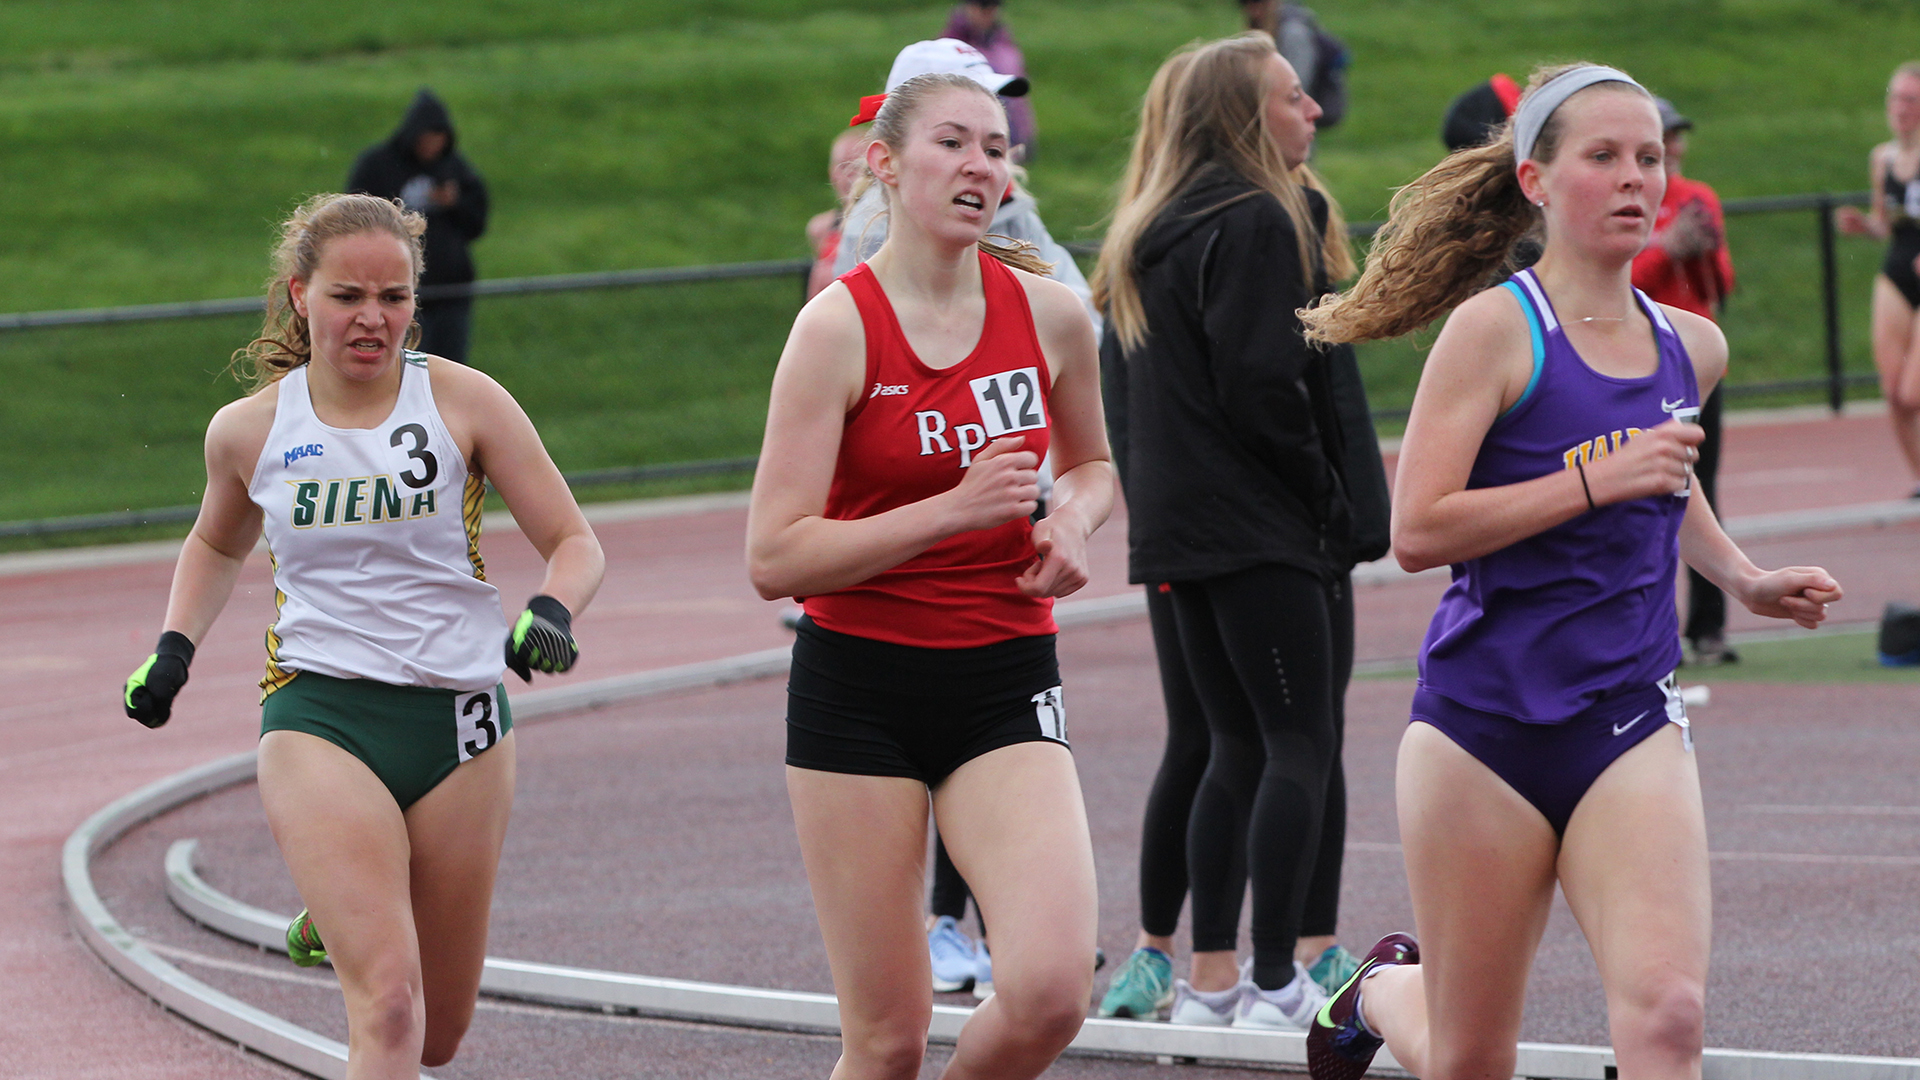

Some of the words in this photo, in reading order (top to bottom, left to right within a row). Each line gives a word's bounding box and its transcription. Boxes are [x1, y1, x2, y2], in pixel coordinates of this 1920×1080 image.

[982, 372, 1041, 430] 12
[283, 443, 324, 469] MAAC
[389, 423, 438, 489] 3
[914, 409, 997, 468] RP
[284, 474, 438, 530] SIENA
[462, 692, 497, 757] 3
